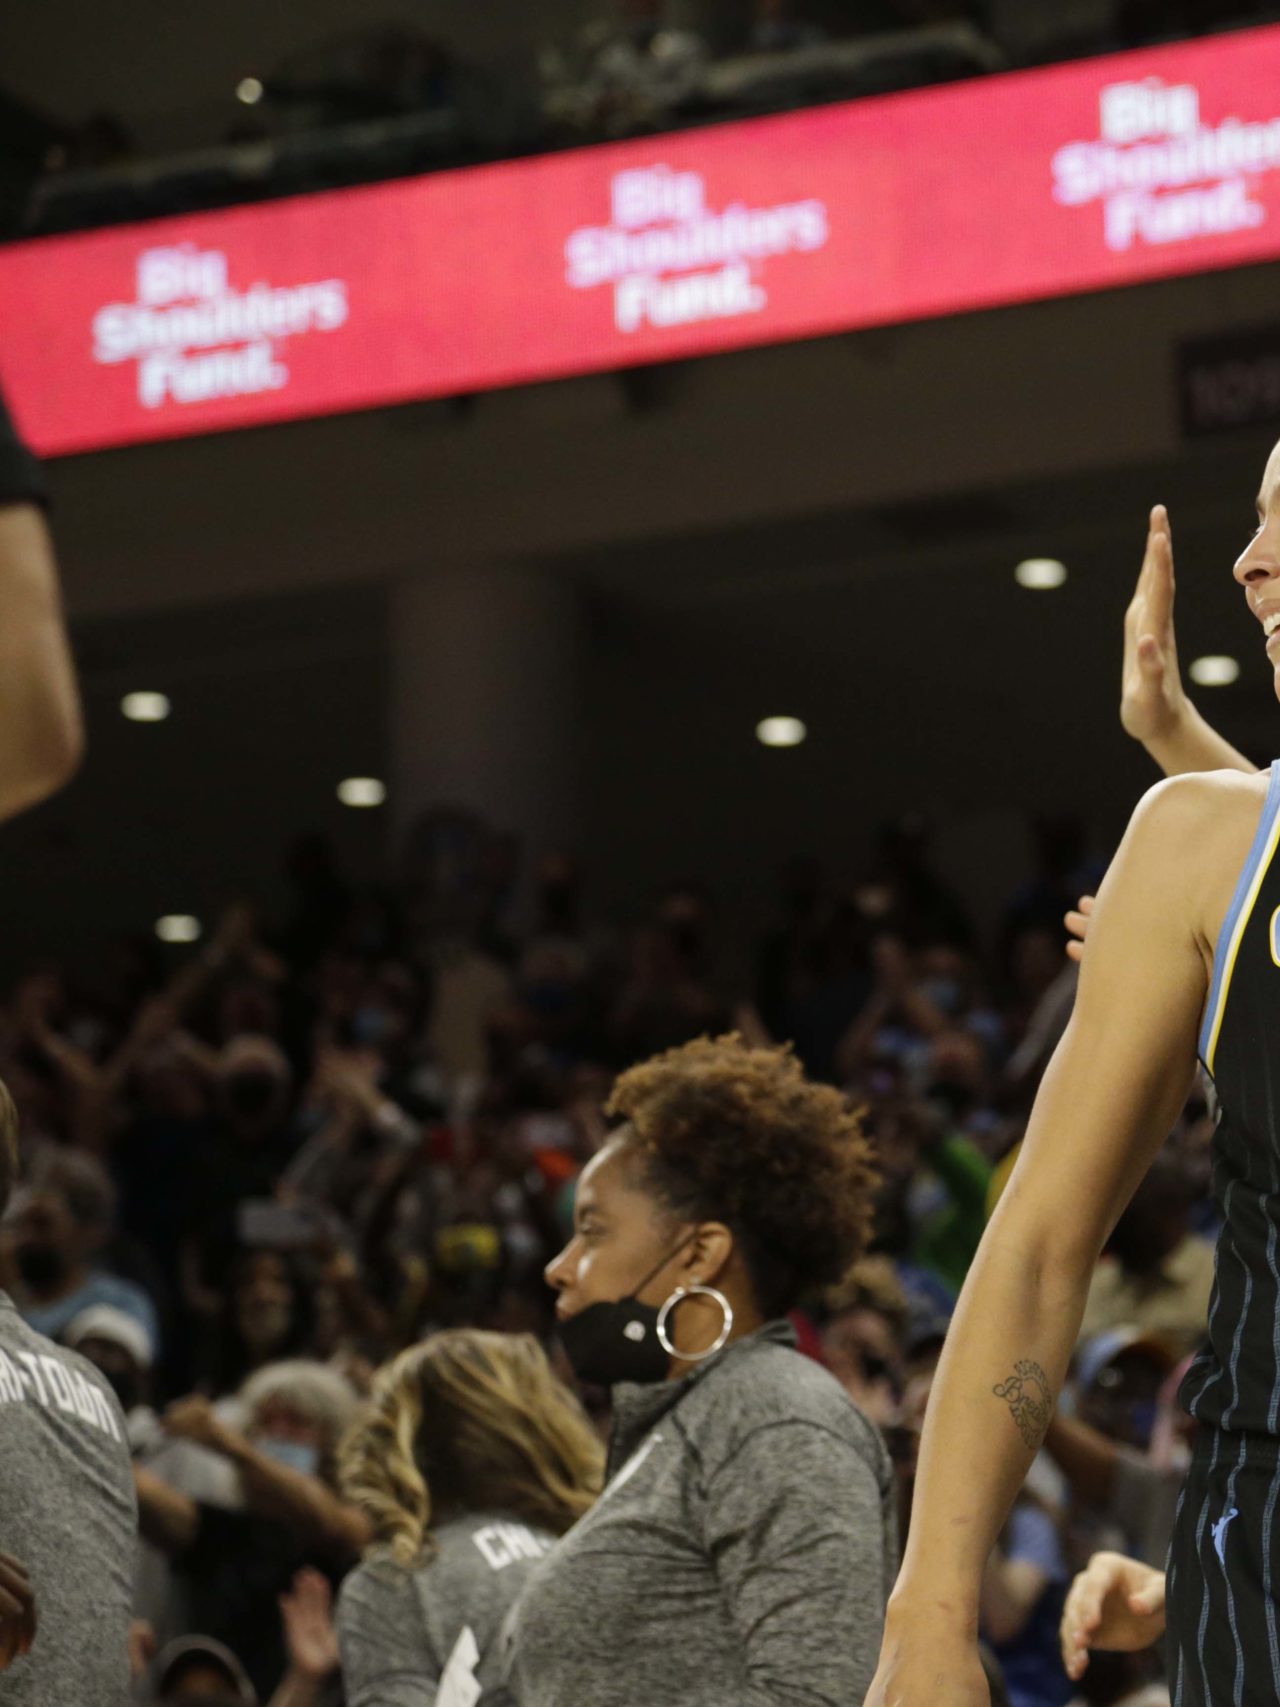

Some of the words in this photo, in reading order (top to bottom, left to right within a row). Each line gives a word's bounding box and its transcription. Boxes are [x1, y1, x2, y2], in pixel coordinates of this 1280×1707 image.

[1101, 76, 1198, 145] Big
[612, 163, 704, 232] Big
[138, 242, 228, 308] Big
[565, 199, 828, 288] Shoulders
[92, 279, 348, 363] Shoulders
